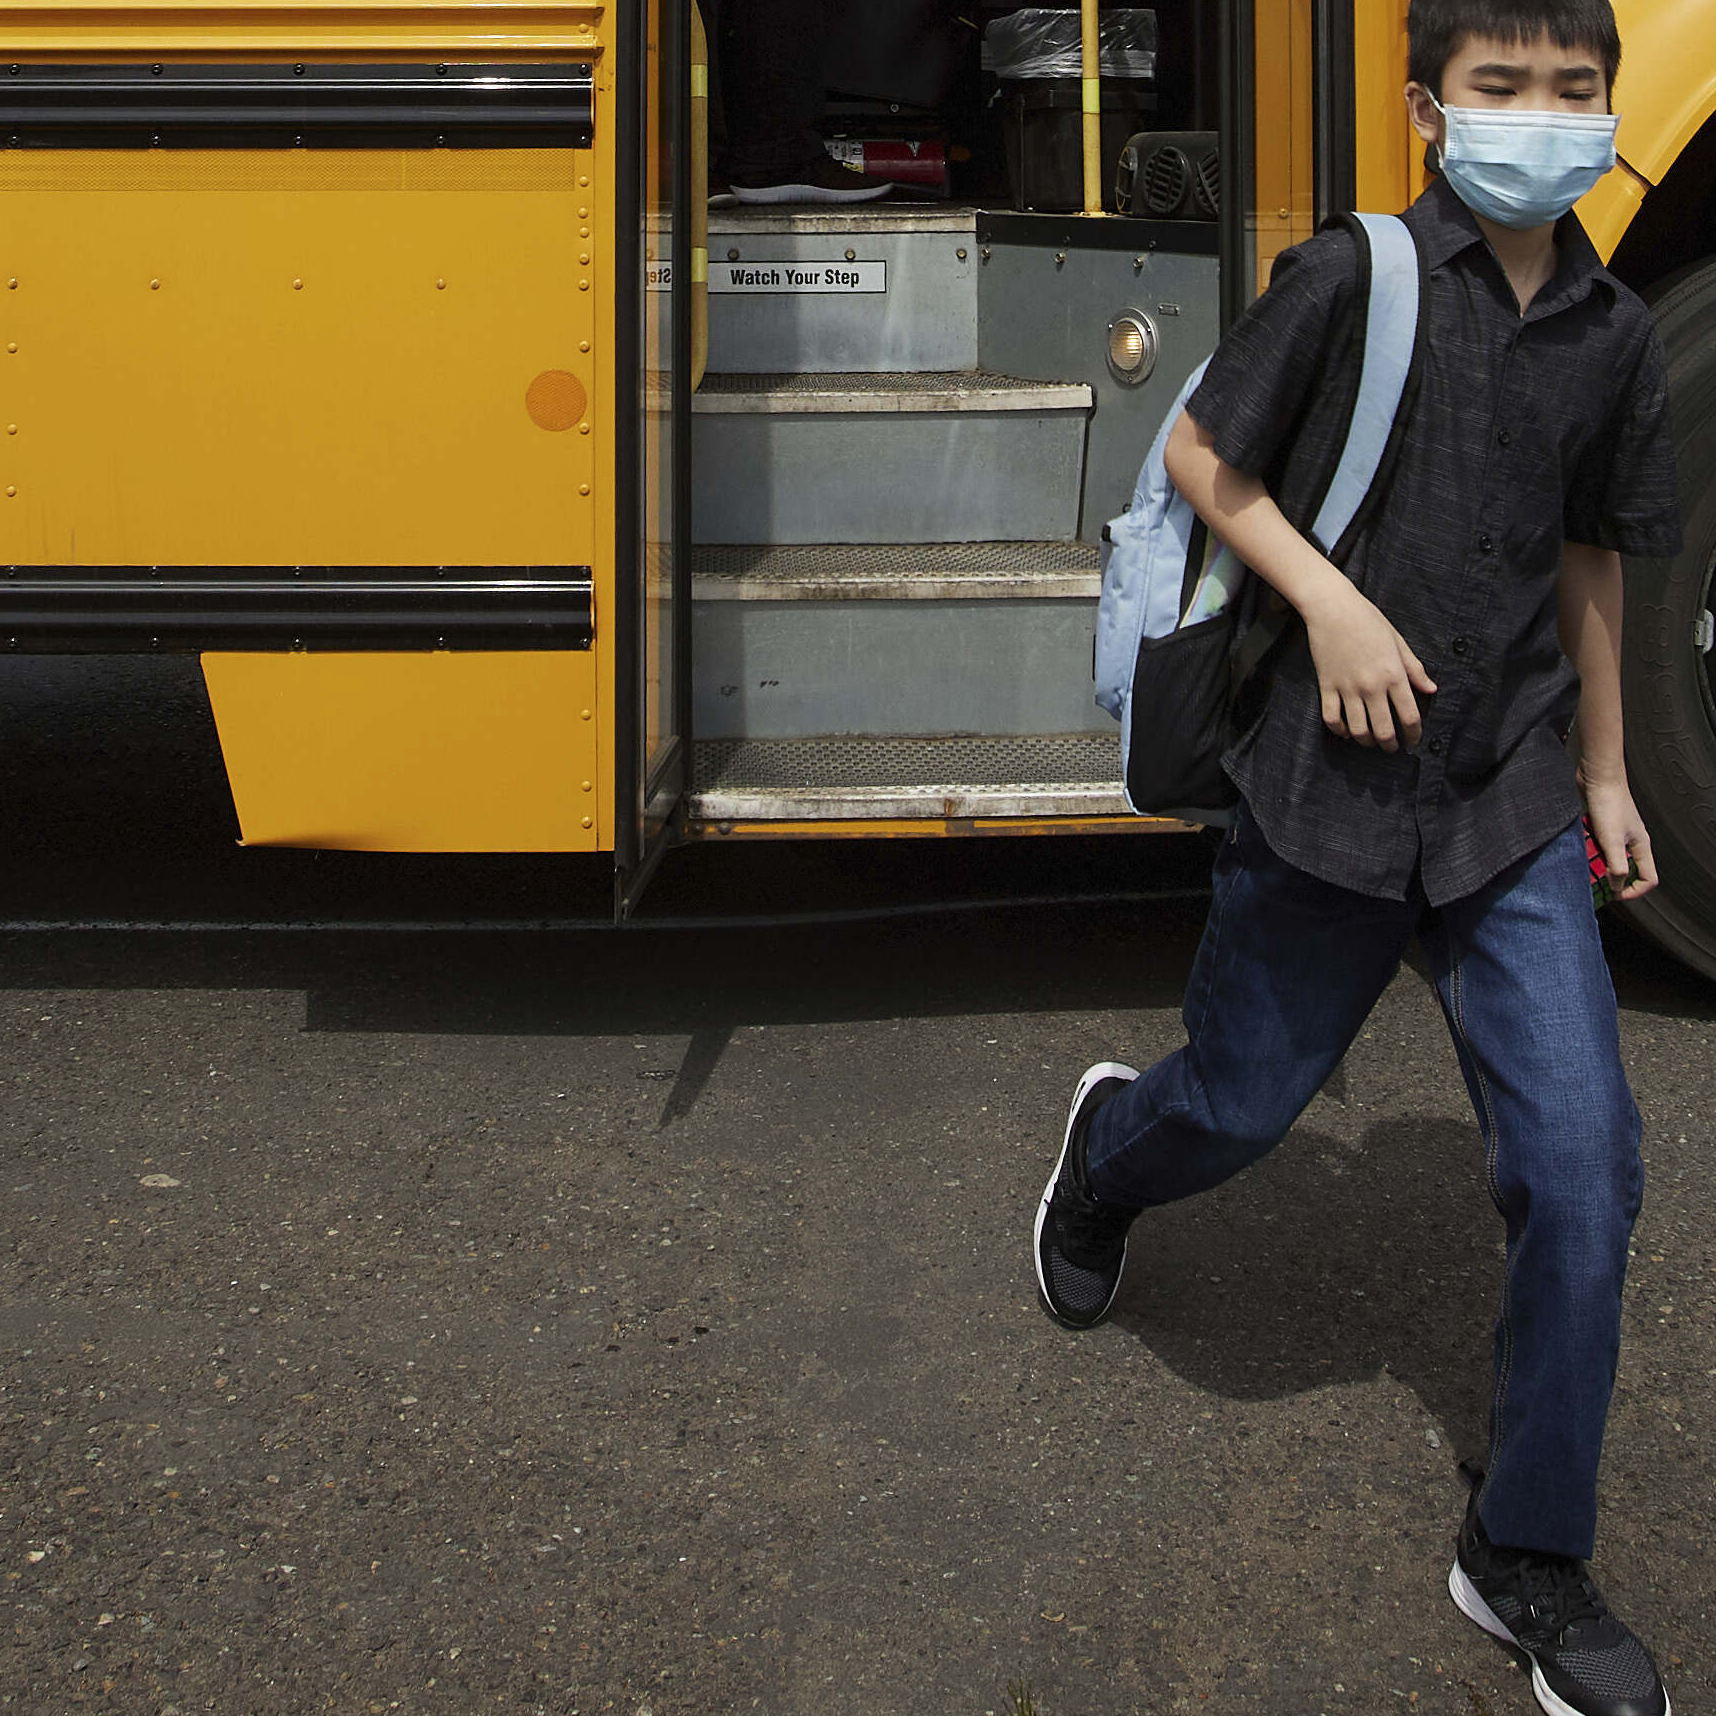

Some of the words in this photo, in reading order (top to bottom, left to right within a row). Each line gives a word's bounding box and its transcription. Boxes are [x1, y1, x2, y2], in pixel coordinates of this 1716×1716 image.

[729, 268, 781, 286] Watch
[784, 268, 820, 286] Your
[824, 268, 860, 289] Step
